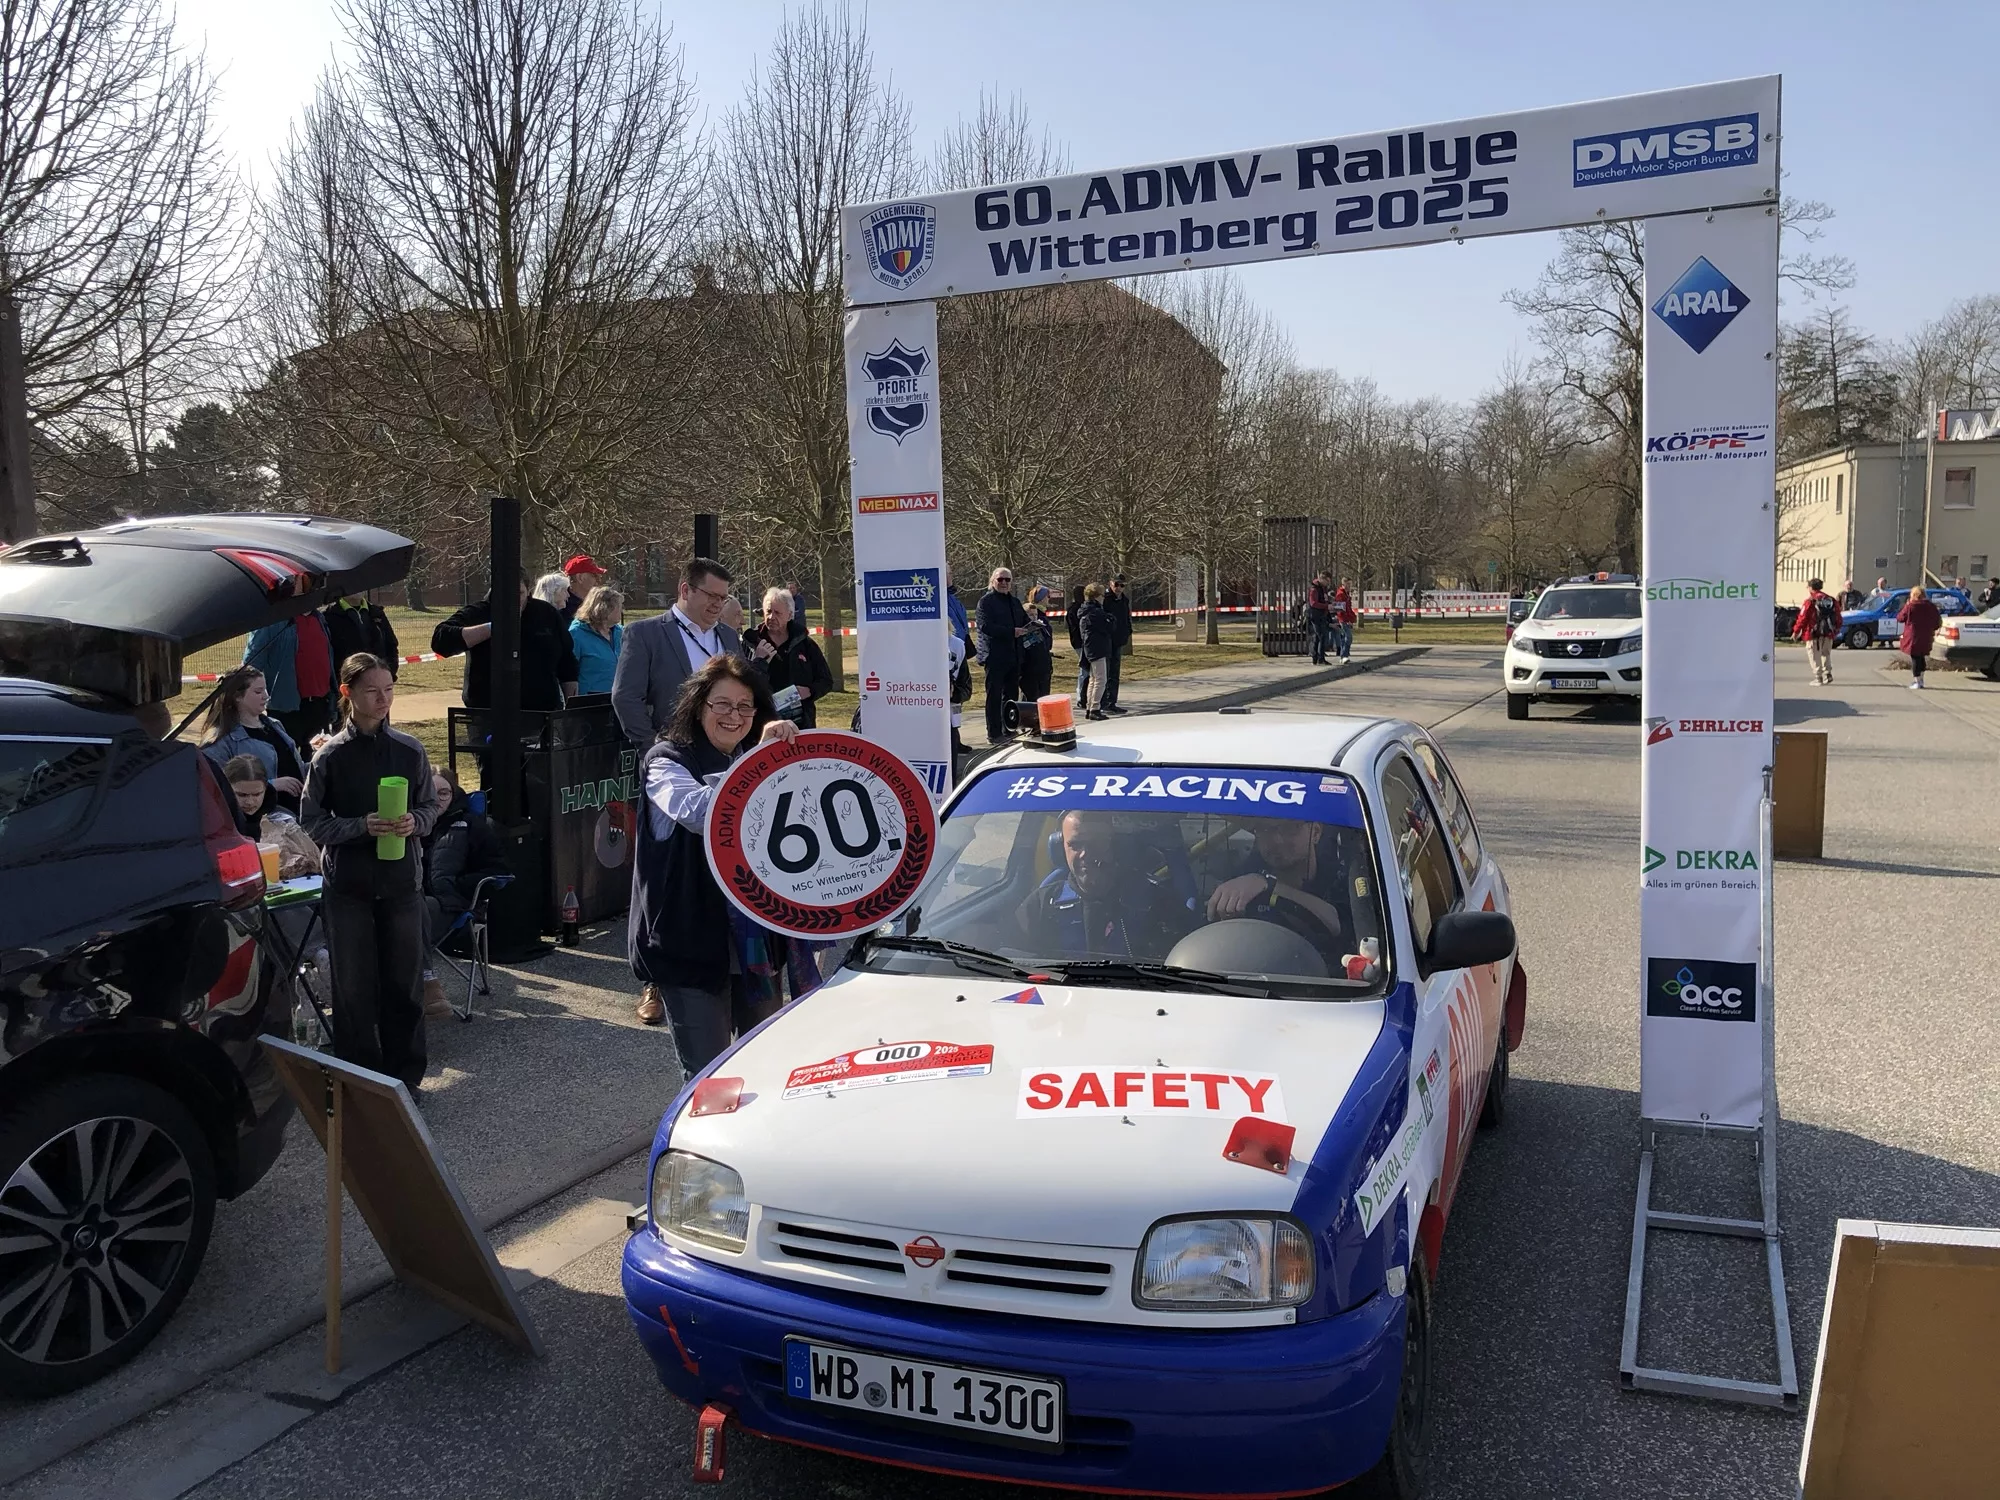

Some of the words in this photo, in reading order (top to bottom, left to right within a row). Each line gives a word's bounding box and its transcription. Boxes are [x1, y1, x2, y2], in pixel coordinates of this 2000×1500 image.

[1576, 122, 1756, 170] DMSB
[1297, 130, 1518, 191] Rallye
[1576, 166, 1629, 182] Deutscher
[1631, 163, 1664, 175] Motor
[1667, 157, 1698, 171] Sport
[1701, 152, 1730, 165] Bund
[870, 204, 926, 225] ALLGEMEINER
[987, 211, 1320, 277] Wittenberg
[1334, 176, 1510, 236] 2025
[863, 228, 879, 271] DEUTSCHER
[876, 220, 925, 257] ADMV
[924, 217, 935, 260] VERBAND
[879, 271, 901, 287] MOTOR
[903, 265, 925, 287] SPORT
[1662, 288, 1738, 318] ARAL
[877, 378, 919, 396] PFORTE
[1646, 431, 1749, 453] KÖPPE
[1644, 453, 1708, 464] Kfz-Werkstatt
[1714, 450, 1768, 460] Motorsport
[860, 496, 936, 512] MEDIMAX
[873, 587, 928, 600] EURONICS
[1646, 579, 1759, 601] schandert
[871, 606, 910, 616] EURONICS
[911, 604, 936, 614] Schnee
[885, 681, 938, 695] Sparkasse
[886, 695, 945, 710] Wittenberg
[1678, 719, 1764, 733] EHRLICH
[718, 801, 738, 849] ADMV
[728, 760, 769, 799] Rallye
[770, 741, 864, 764] Lutherstadt
[869, 753, 920, 824] Wittenberg
[1007, 775, 1307, 806] #S-RACING
[767, 778, 903, 875] 60.
[1676, 850, 1759, 871] DEKRA
[791, 880, 814, 893] MSC
[815, 869, 868, 887] Wittenberg
[869, 863, 886, 875] e.V.
[1645, 879, 1668, 889] Alles
[1670, 879, 1682, 889] im
[1684, 879, 1718, 891] grünen
[1721, 879, 1760, 890] Bereich.
[821, 891, 834, 901] im
[836, 883, 865, 897] ADMV
[1679, 1004, 1696, 1012] Clean
[1702, 1006, 1720, 1014] Green
[874, 1045, 921, 1062] 000
[934, 1045, 959, 1056] 2025
[812, 1066, 852, 1080] ADMV
[1025, 1072, 1275, 1114] SAFETY
[1372, 1152, 1403, 1207] DEKRA
[795, 1376, 803, 1390] D
[811, 1351, 860, 1402] WB
[890, 1365, 938, 1416] MI
[953, 1376, 1054, 1435] 1300
